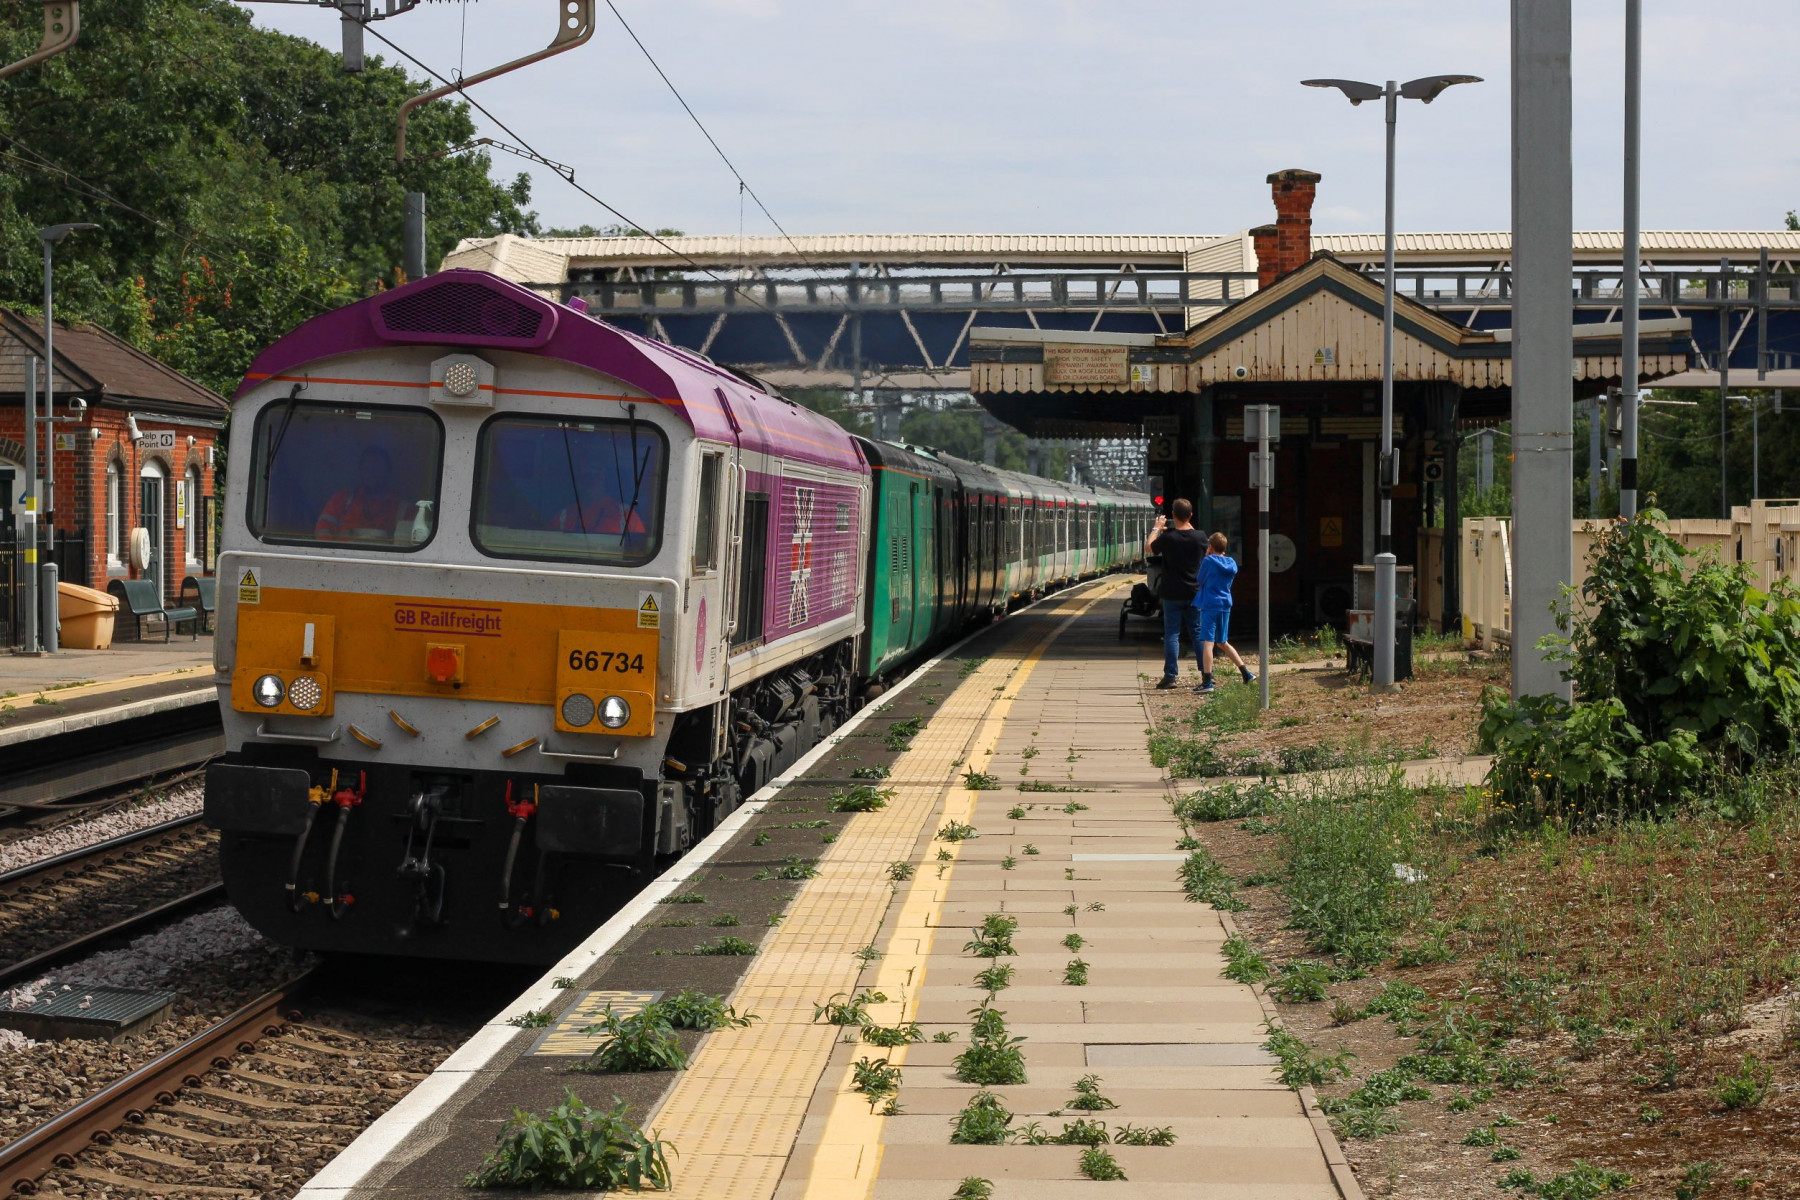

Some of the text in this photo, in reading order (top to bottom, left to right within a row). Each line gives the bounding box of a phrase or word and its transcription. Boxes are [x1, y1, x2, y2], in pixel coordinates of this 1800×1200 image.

[139, 440, 159, 448] Point
[142, 432, 157, 441] elp
[1157, 439, 1171, 458] 3
[394, 609, 502, 633] GB Railfreight
[569, 649, 645, 674] 66734
